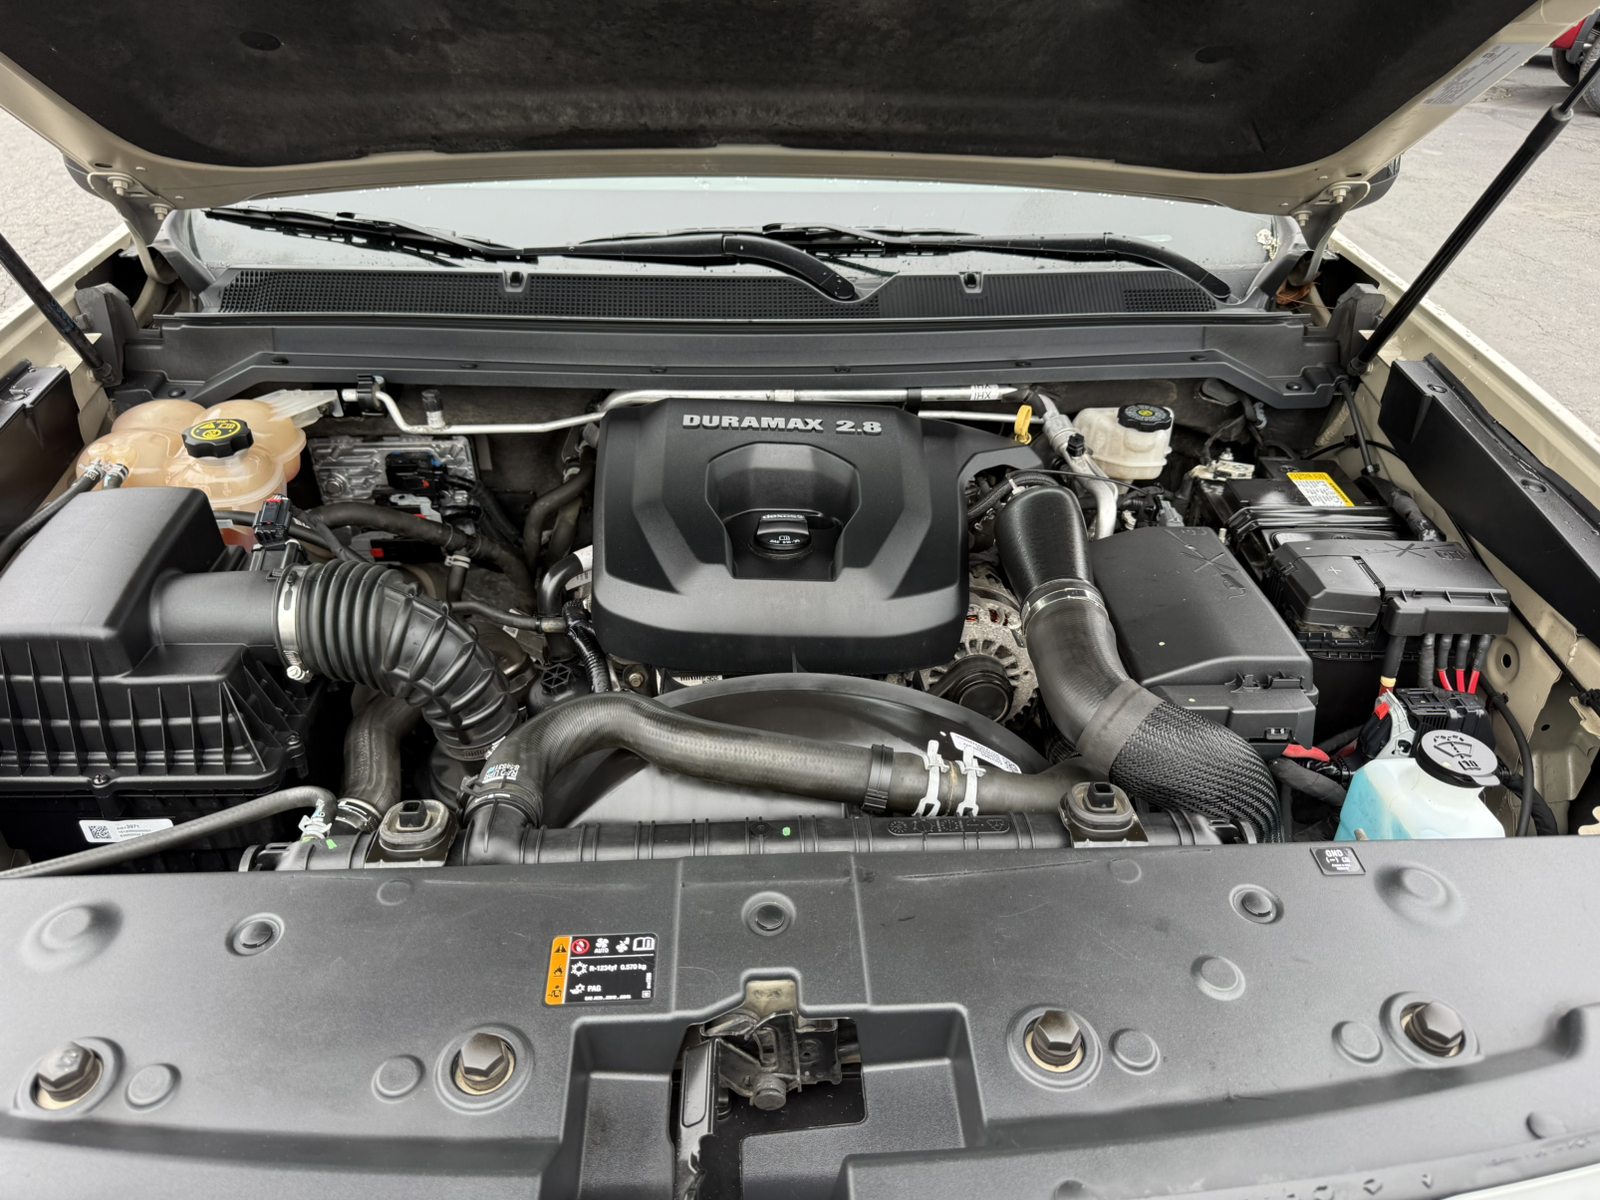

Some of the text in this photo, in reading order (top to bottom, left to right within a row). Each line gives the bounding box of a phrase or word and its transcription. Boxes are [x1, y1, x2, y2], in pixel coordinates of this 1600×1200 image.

[682, 414, 882, 435] DURAMAX 2.8
[1325, 849, 1343, 857] GND
